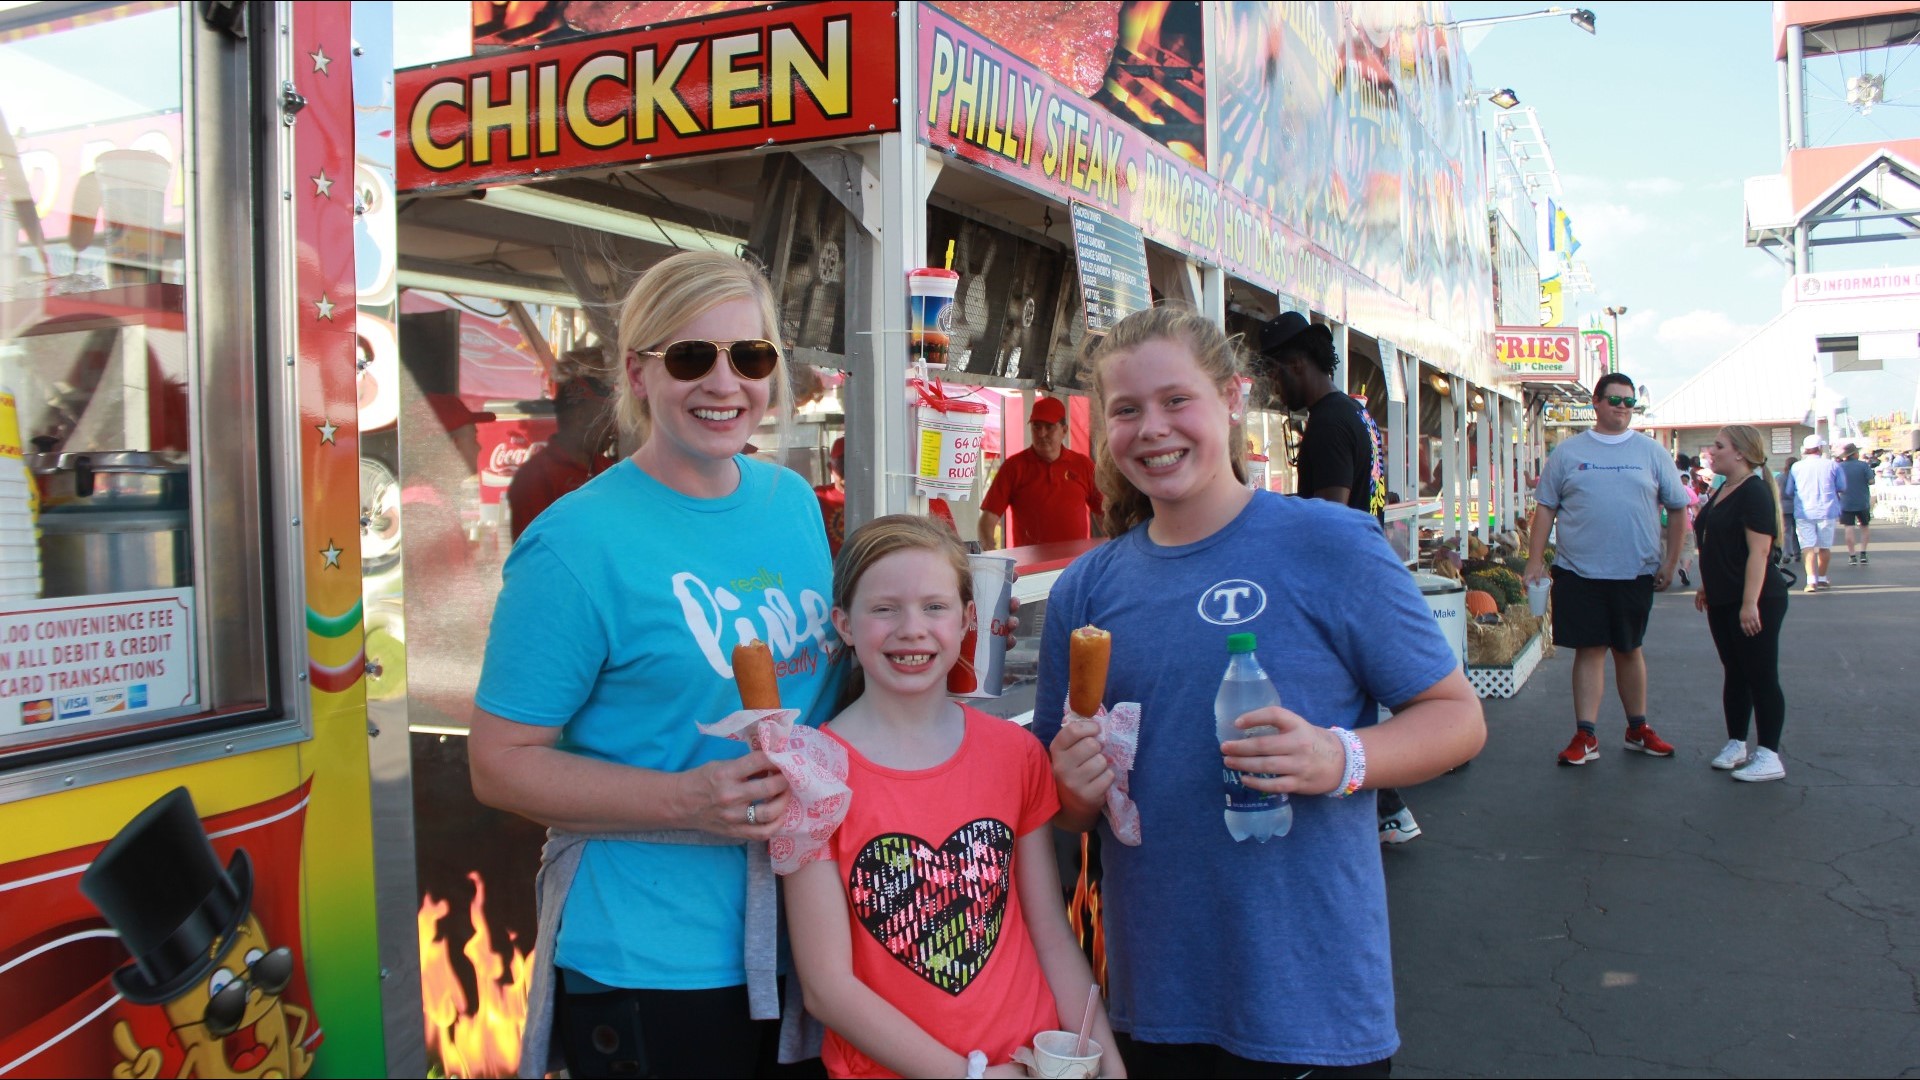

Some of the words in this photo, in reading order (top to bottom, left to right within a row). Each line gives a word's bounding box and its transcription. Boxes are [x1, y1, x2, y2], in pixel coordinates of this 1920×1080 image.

[410, 17, 848, 170] CHICKEN
[927, 31, 1042, 166] PHILLY
[1042, 97, 1123, 206] STEAK
[1143, 152, 1218, 250] BURGERS
[1223, 200, 1252, 267] HOT
[1255, 220, 1288, 286] DOGS
[1823, 275, 1910, 291] INFORMATION
[1531, 362, 1563, 371] Cheese
[1570, 406, 1597, 421] LEMONA
[954, 437, 970, 449] 64
[729, 566, 784, 593] really
[1213, 586, 1250, 621] T
[1433, 608, 1456, 619] Make
[35, 611, 144, 640] CONVENIENCE
[149, 609, 173, 629] FEE
[16, 649, 47, 669] ALL
[53, 641, 99, 665] DEBIT
[104, 640, 115, 659] &
[120, 633, 172, 656] CREDIT
[0, 675, 44, 698] CARD
[48, 659, 165, 691] TRANSACTIONS
[62, 696, 88, 711] VISA
